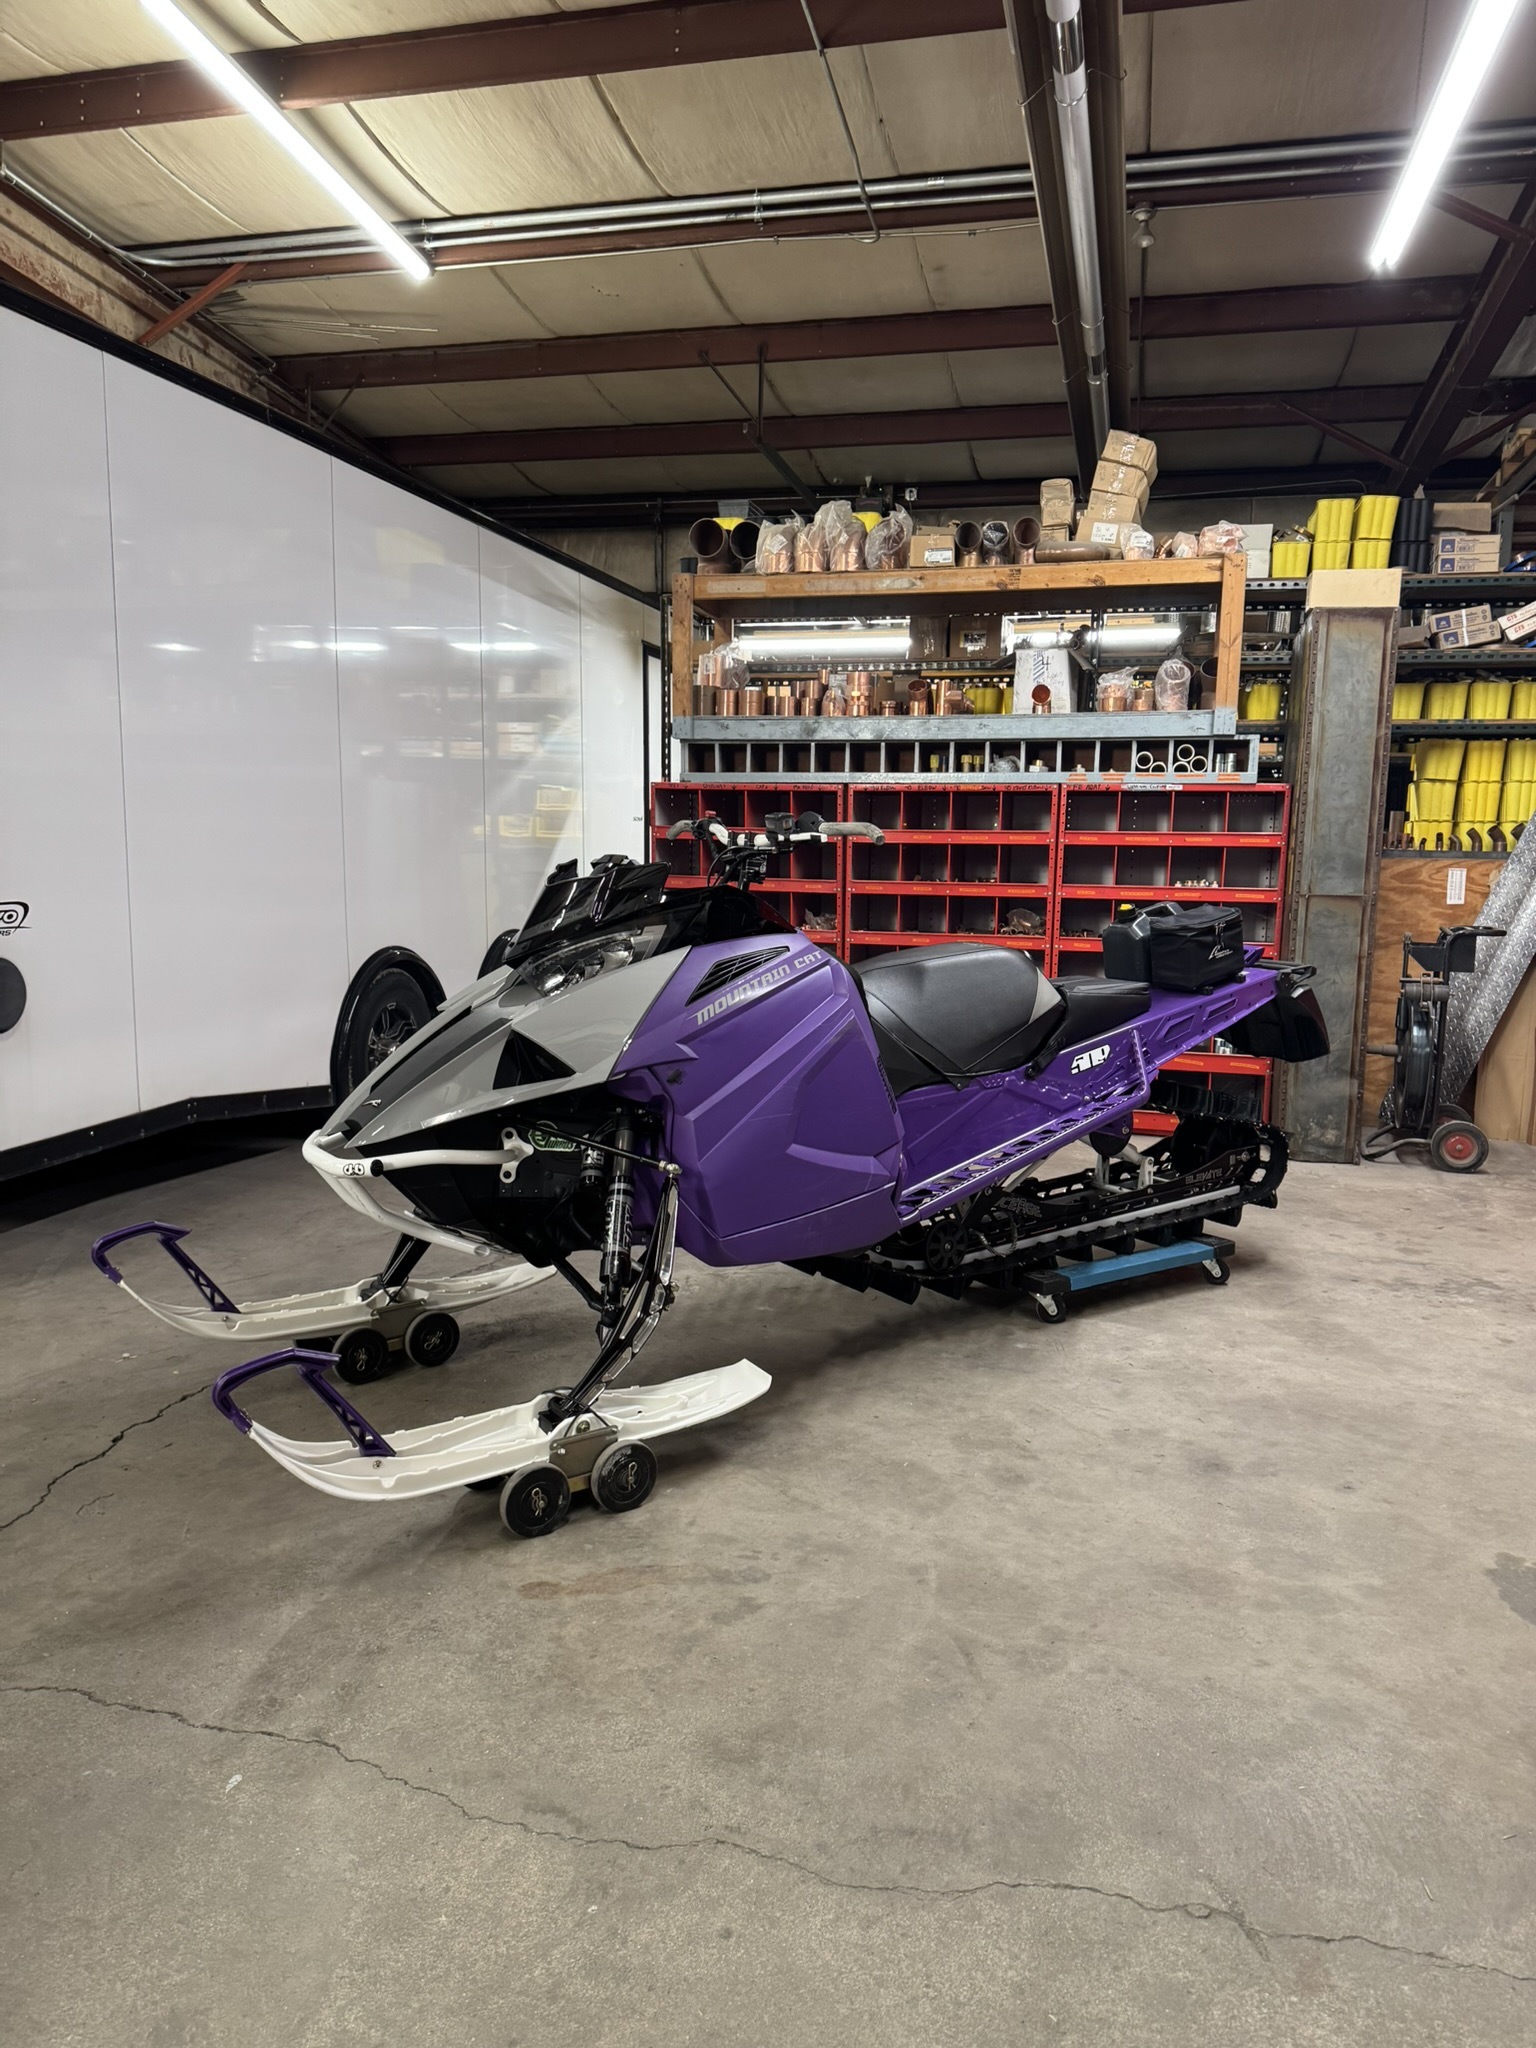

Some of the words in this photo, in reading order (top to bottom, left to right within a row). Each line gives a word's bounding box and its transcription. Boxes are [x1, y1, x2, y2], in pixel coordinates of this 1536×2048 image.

[688, 965, 791, 1026] MOUNTAIN
[794, 950, 822, 969] CAT
[1071, 1044, 1111, 1075] 509
[1185, 1168, 1223, 1185] ELEVATE
